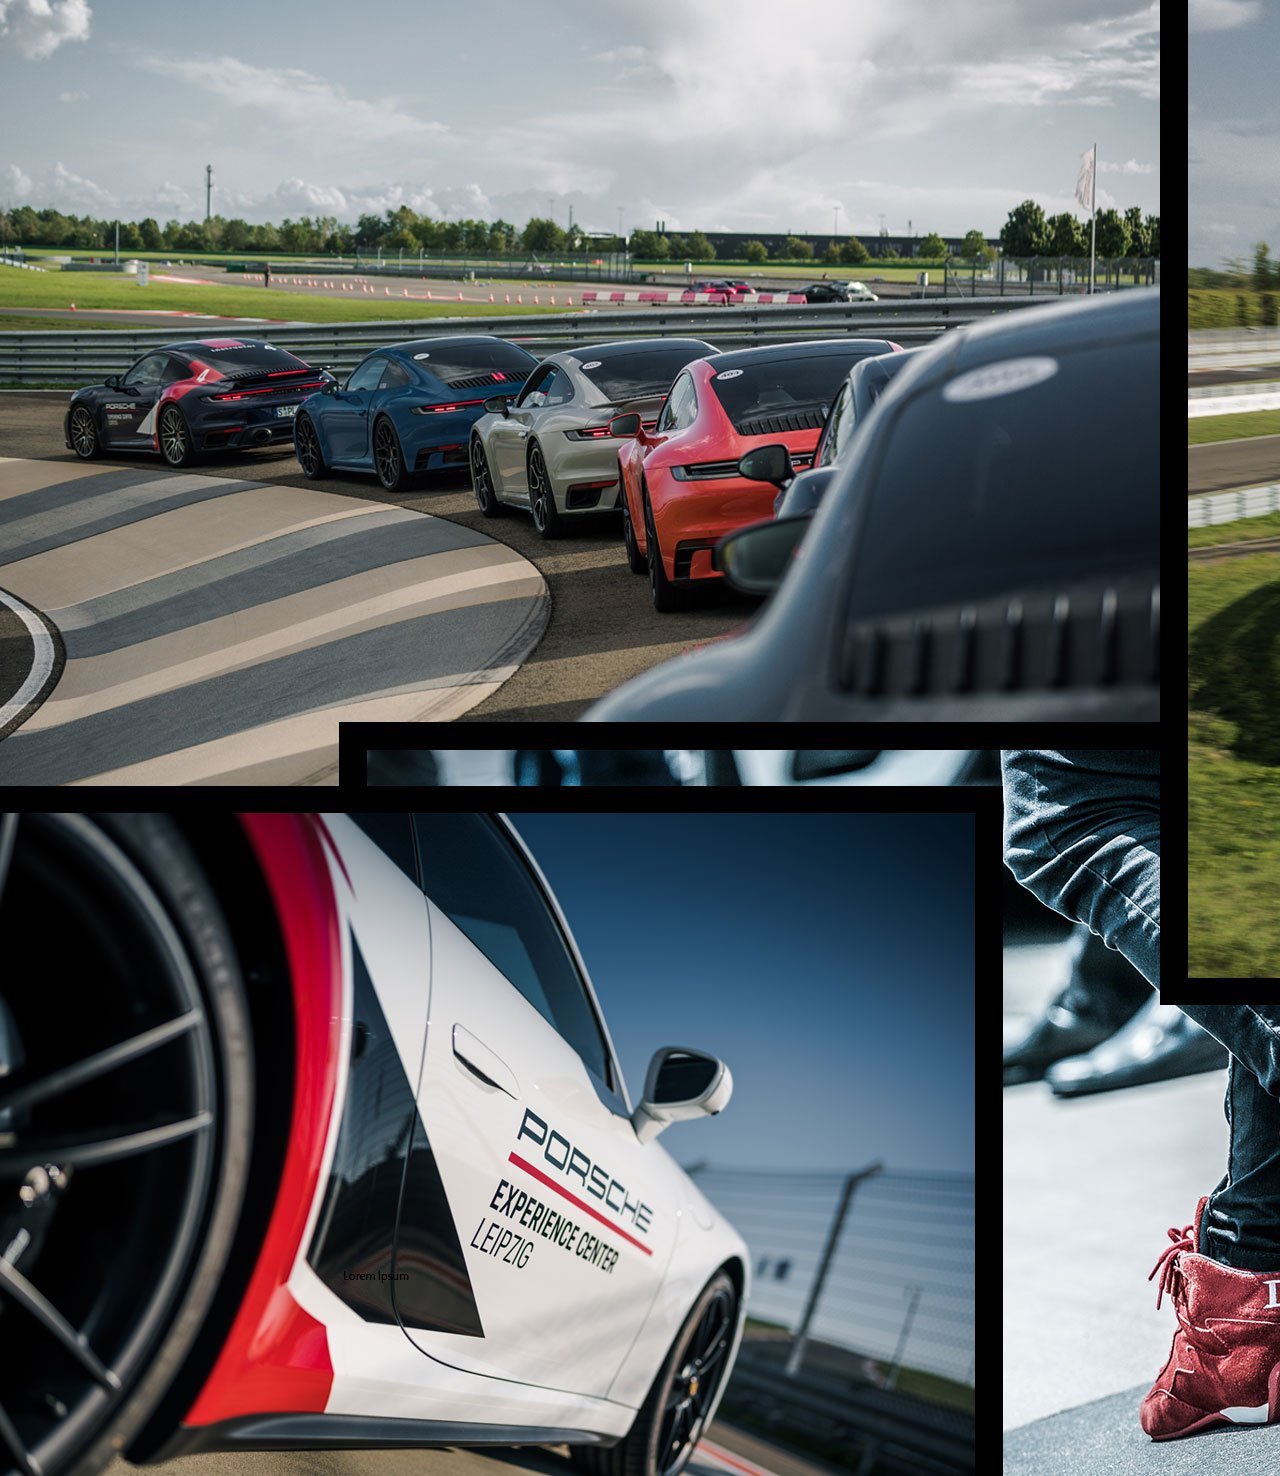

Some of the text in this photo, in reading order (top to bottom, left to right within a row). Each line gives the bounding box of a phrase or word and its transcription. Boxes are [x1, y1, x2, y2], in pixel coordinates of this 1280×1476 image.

[196, 368, 210, 383] 4
[516, 1107, 654, 1234] PORSCHE
[470, 1217, 534, 1269] LEIPZIG
[489, 1178, 620, 1274] EXPERIENCE CENTER
